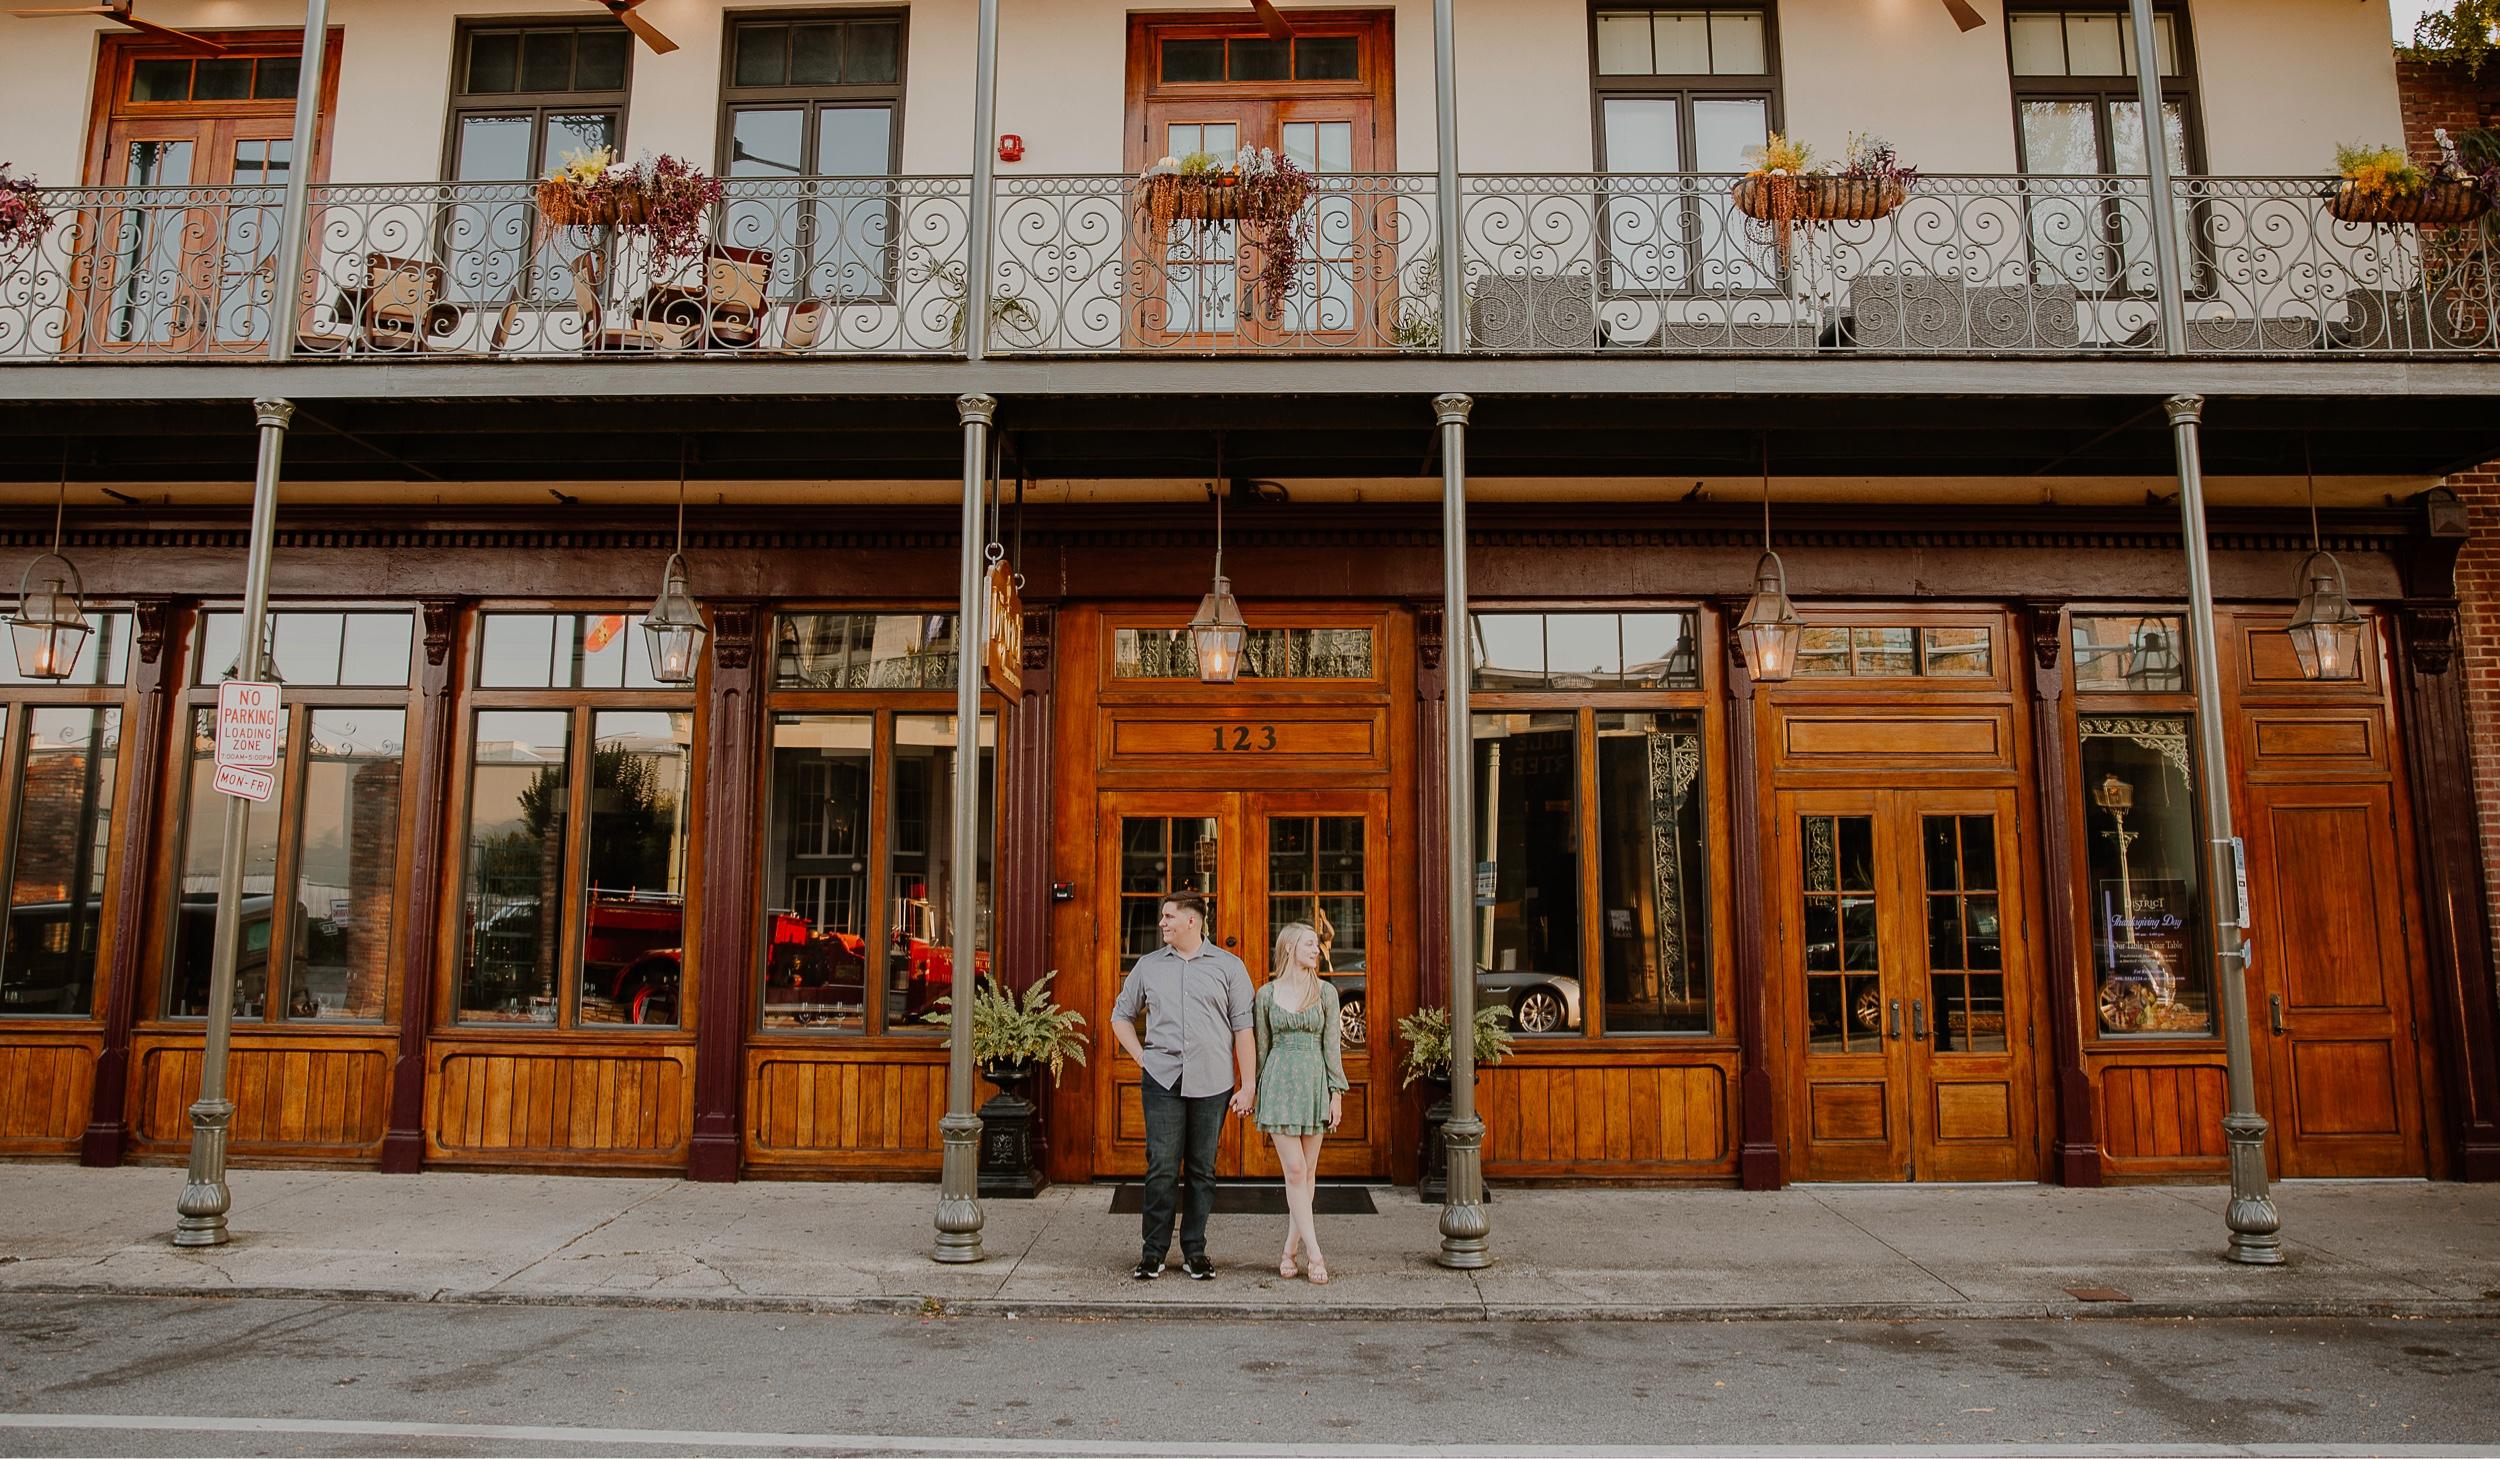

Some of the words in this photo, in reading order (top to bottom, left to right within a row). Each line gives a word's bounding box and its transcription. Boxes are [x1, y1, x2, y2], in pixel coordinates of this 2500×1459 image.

[239, 690, 261, 706] NO
[224, 708, 274, 725] PARKING
[224, 727, 272, 740] LOADING
[1212, 725, 1277, 751] 123
[232, 740, 261, 751] ZONE
[220, 772, 268, 792] MON-FRI
[2111, 914, 2160, 929] Thanksgiving
[2161, 914, 2182, 929] Day
[2112, 941, 2125, 949] Our
[2127, 941, 2143, 950] Table
[2144, 941, 2149, 949] is
[2150, 941, 2164, 949] Your
[2165, 941, 2182, 949] Table
